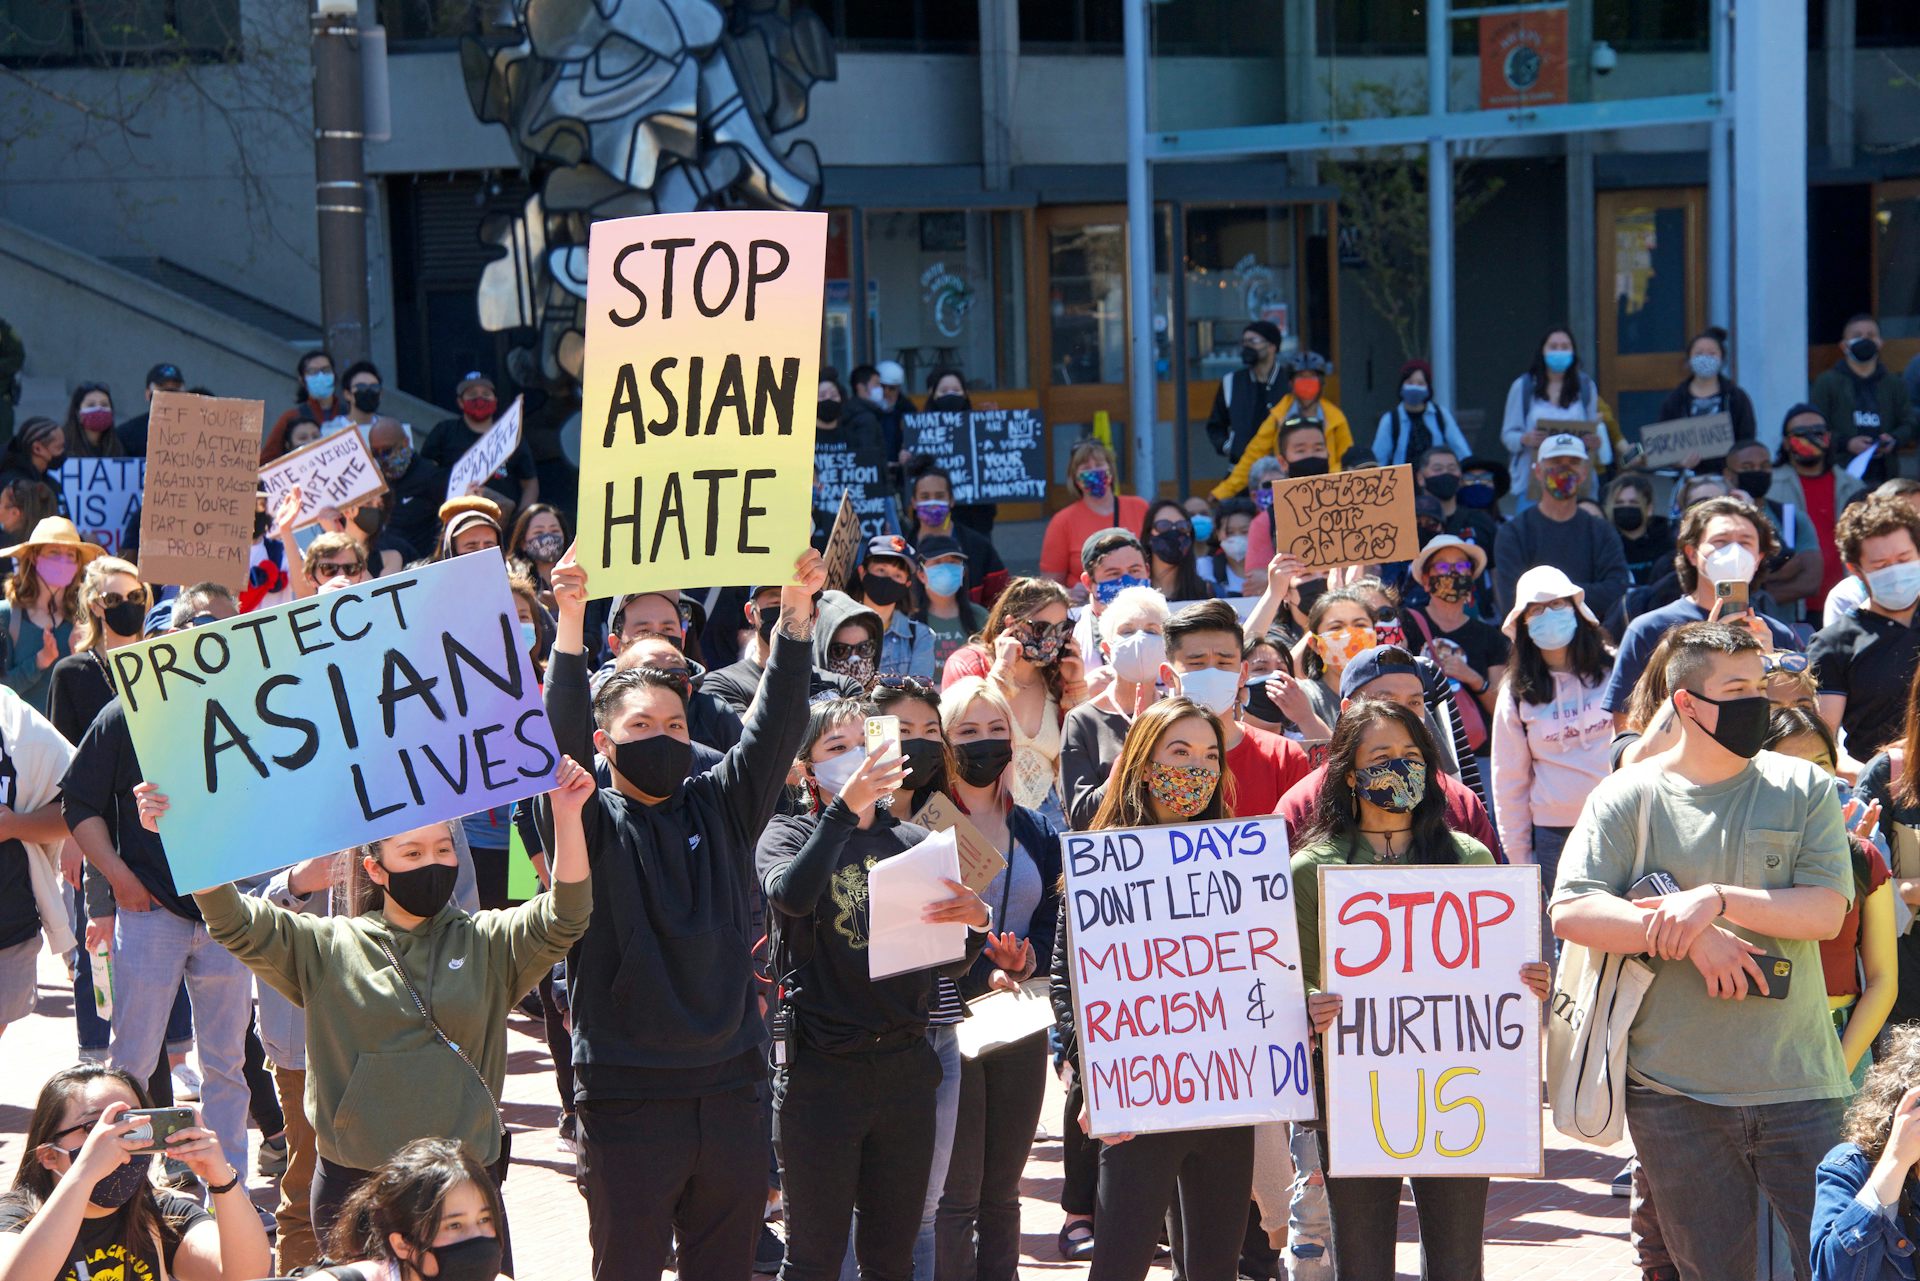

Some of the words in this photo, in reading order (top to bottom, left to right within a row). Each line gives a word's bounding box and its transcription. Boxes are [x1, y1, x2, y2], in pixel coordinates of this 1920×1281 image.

[608, 238, 790, 327] STOP
[159, 407, 189, 423] IF
[602, 353, 800, 448] ASIAN
[974, 410, 1007, 421] WHAT
[1013, 408, 1030, 420] WE
[904, 412, 940, 429] WHAT
[942, 411, 964, 427] WE
[160, 425, 188, 445] NOT
[196, 431, 261, 455] ACTIVELY
[315, 438, 358, 466] VIRUS
[984, 450, 1024, 468] YOUR
[155, 450, 205, 468] TAKING
[207, 451, 216, 467] A
[221, 455, 258, 472] STAND
[327, 457, 366, 502] HATE
[983, 466, 1030, 482] MODEL
[153, 472, 212, 488] AGAINST
[217, 477, 258, 492] RACIST
[981, 480, 1046, 498] MINORITY
[76, 494, 107, 527] IS
[153, 490, 187, 508] HATE
[195, 491, 239, 515] YOU'RE
[602, 469, 776, 568] HATE
[1319, 507, 1364, 532] our
[151, 514, 187, 532] PART
[194, 522, 213, 535] OF
[220, 523, 248, 539] THE
[1290, 523, 1398, 567] elders
[168, 538, 241, 564] PROBLEM
[115, 579, 418, 711] PROTECT
[204, 613, 524, 793] ASIAN
[350, 709, 556, 821] LIVES
[1068, 834, 1144, 877] BAD
[1168, 822, 1267, 865] DAYS
[1074, 879, 1155, 932] DON'T
[1166, 870, 1242, 920] LEAD
[1252, 872, 1288, 902] TO
[1334, 890, 1515, 977] STOP
[1079, 927, 1297, 984] MURDER.
[1085, 987, 1227, 1043] RACISM
[1246, 978, 1274, 1029] &
[1336, 993, 1524, 1057] HURTING
[1091, 1045, 1258, 1111] MISOGYNY
[1269, 1042, 1309, 1097] DO
[1369, 1066, 1486, 1159] US
[85, 1243, 127, 1265] LACK
